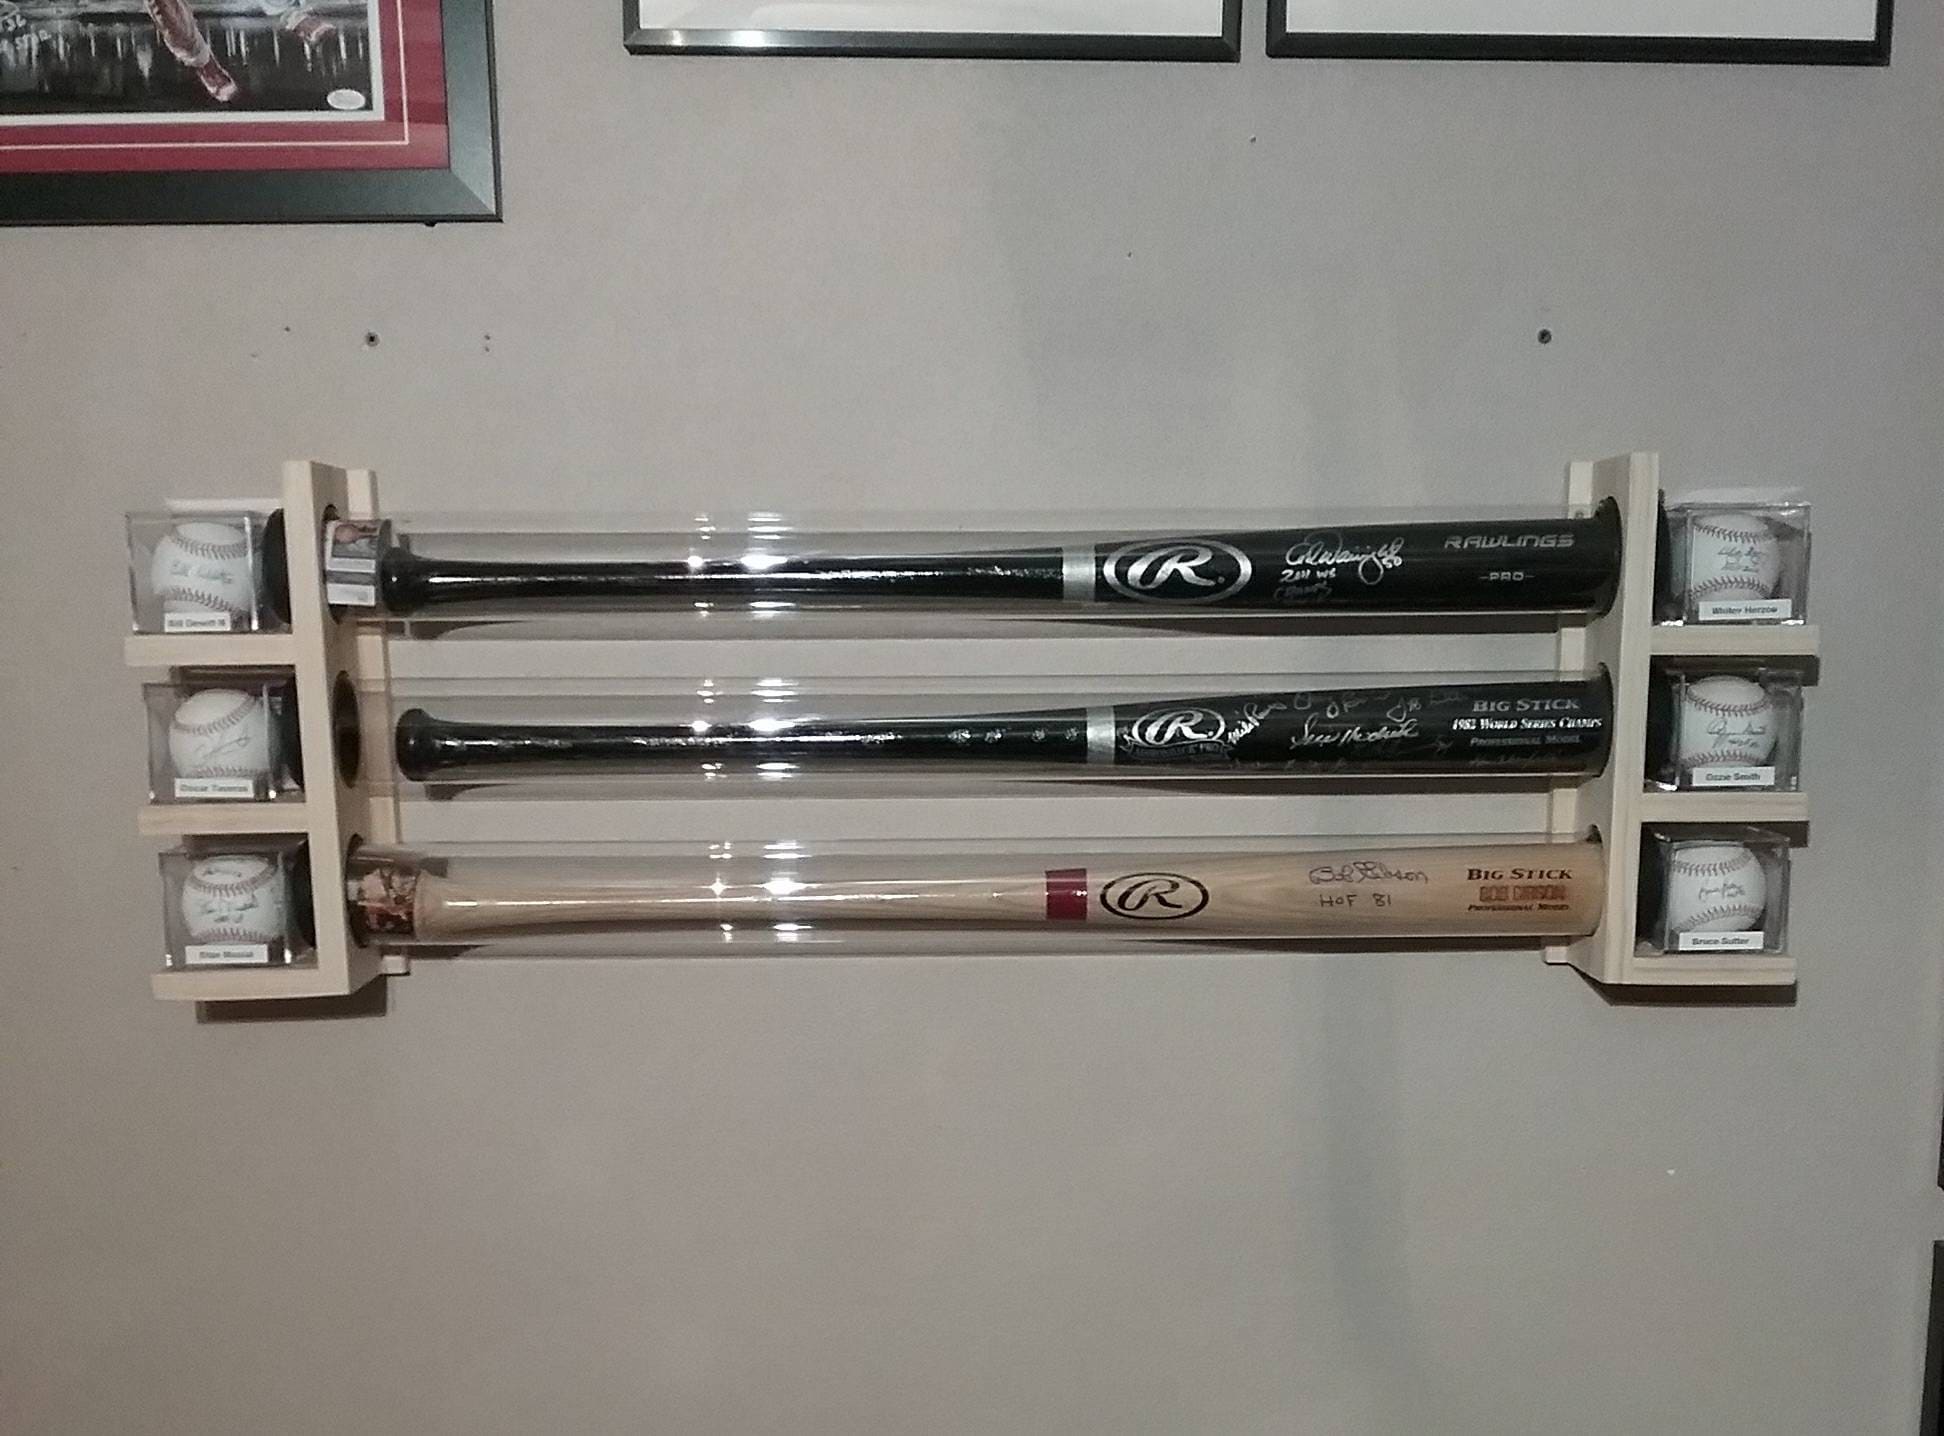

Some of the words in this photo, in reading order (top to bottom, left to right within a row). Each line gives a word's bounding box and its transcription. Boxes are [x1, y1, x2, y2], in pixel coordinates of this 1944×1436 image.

[1444, 534, 1575, 549] RAWLINGS
[1472, 700, 1512, 712] BIG
[1516, 698, 1580, 711] STICK
[1480, 718, 1518, 730] WORLD
[1467, 868, 1504, 880] BIG
[1510, 868, 1573, 880] STICK
